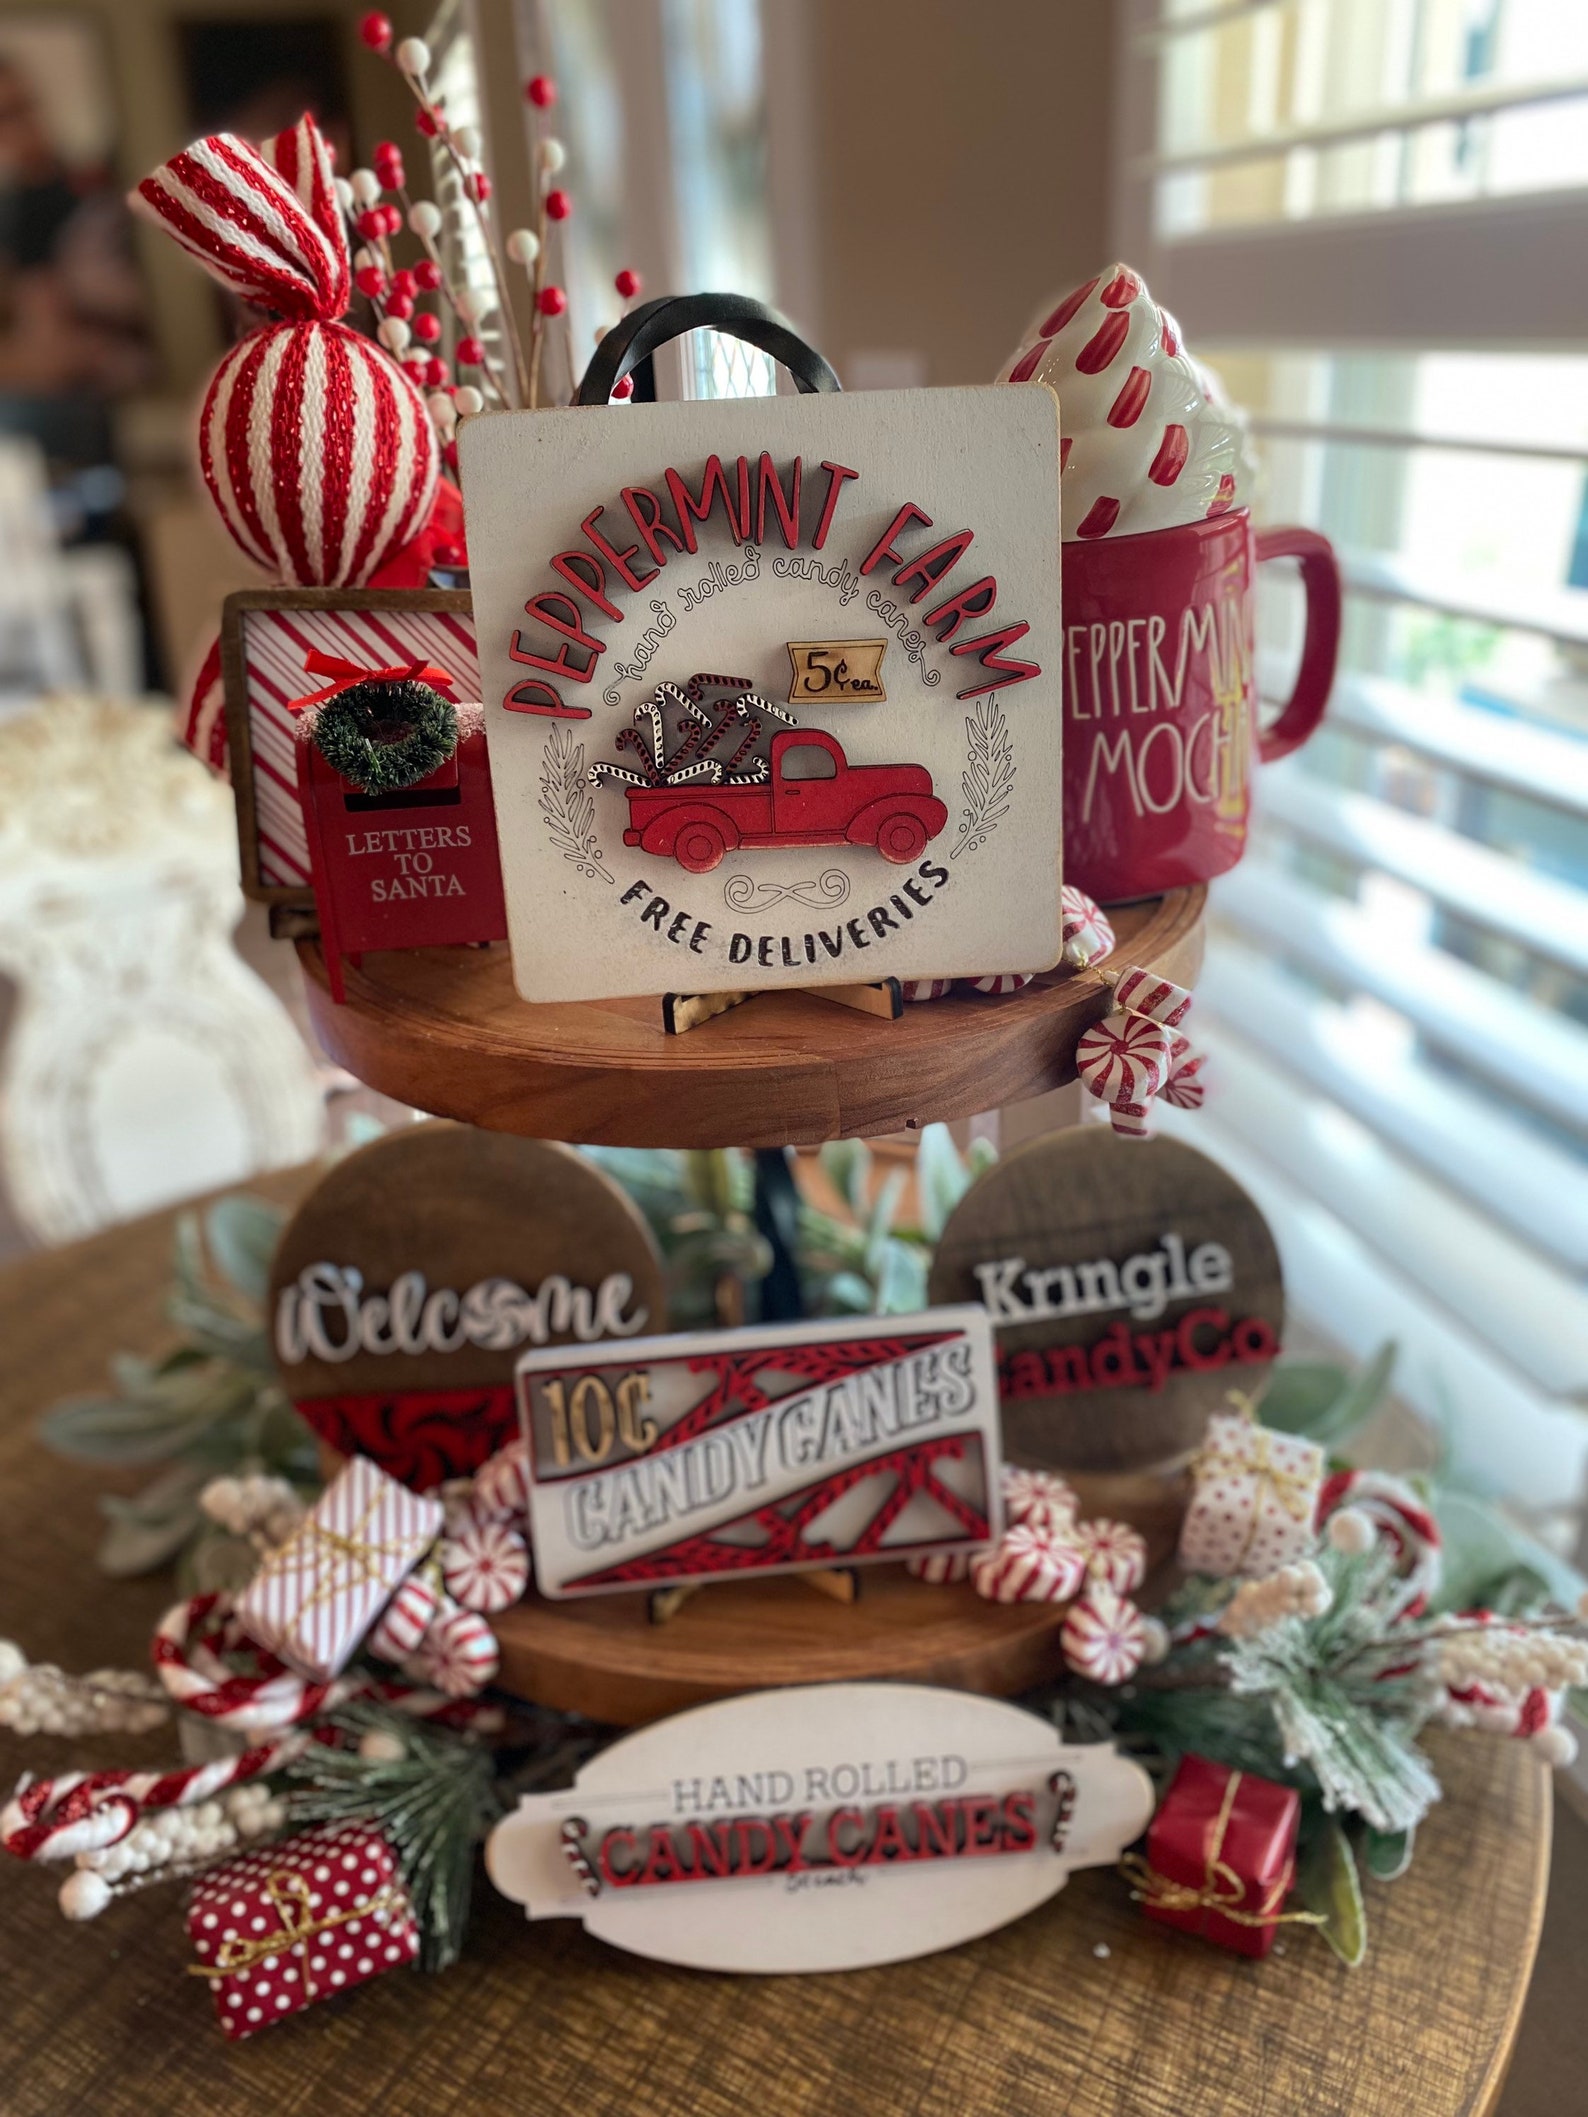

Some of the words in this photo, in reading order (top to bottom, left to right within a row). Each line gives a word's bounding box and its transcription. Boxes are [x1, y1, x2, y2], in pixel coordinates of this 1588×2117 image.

[503, 452, 859, 720] PEPPERMINT
[860, 502, 1042, 701] FARM
[603, 600, 677, 706] hand
[678, 545, 761, 611] rolled
[773, 557, 860, 606] candy
[866, 590, 941, 687] canes
[345, 825, 472, 856] LETTERS
[394, 852, 433, 875] TO
[370, 874, 466, 902] SANTA
[618, 879, 712, 956] FREE
[728, 859, 951, 967] DELIVERIES
[275, 1261, 649, 1365] Welcome
[974, 1232, 1233, 1326] Kringle
[995, 1307, 1283, 1400] andyCo
[670, 1769, 797, 1813] HAND
[805, 1755, 968, 1801] ROLLED
[600, 1809, 815, 1888] CANDY
[826, 1789, 1038, 1867] CANES
